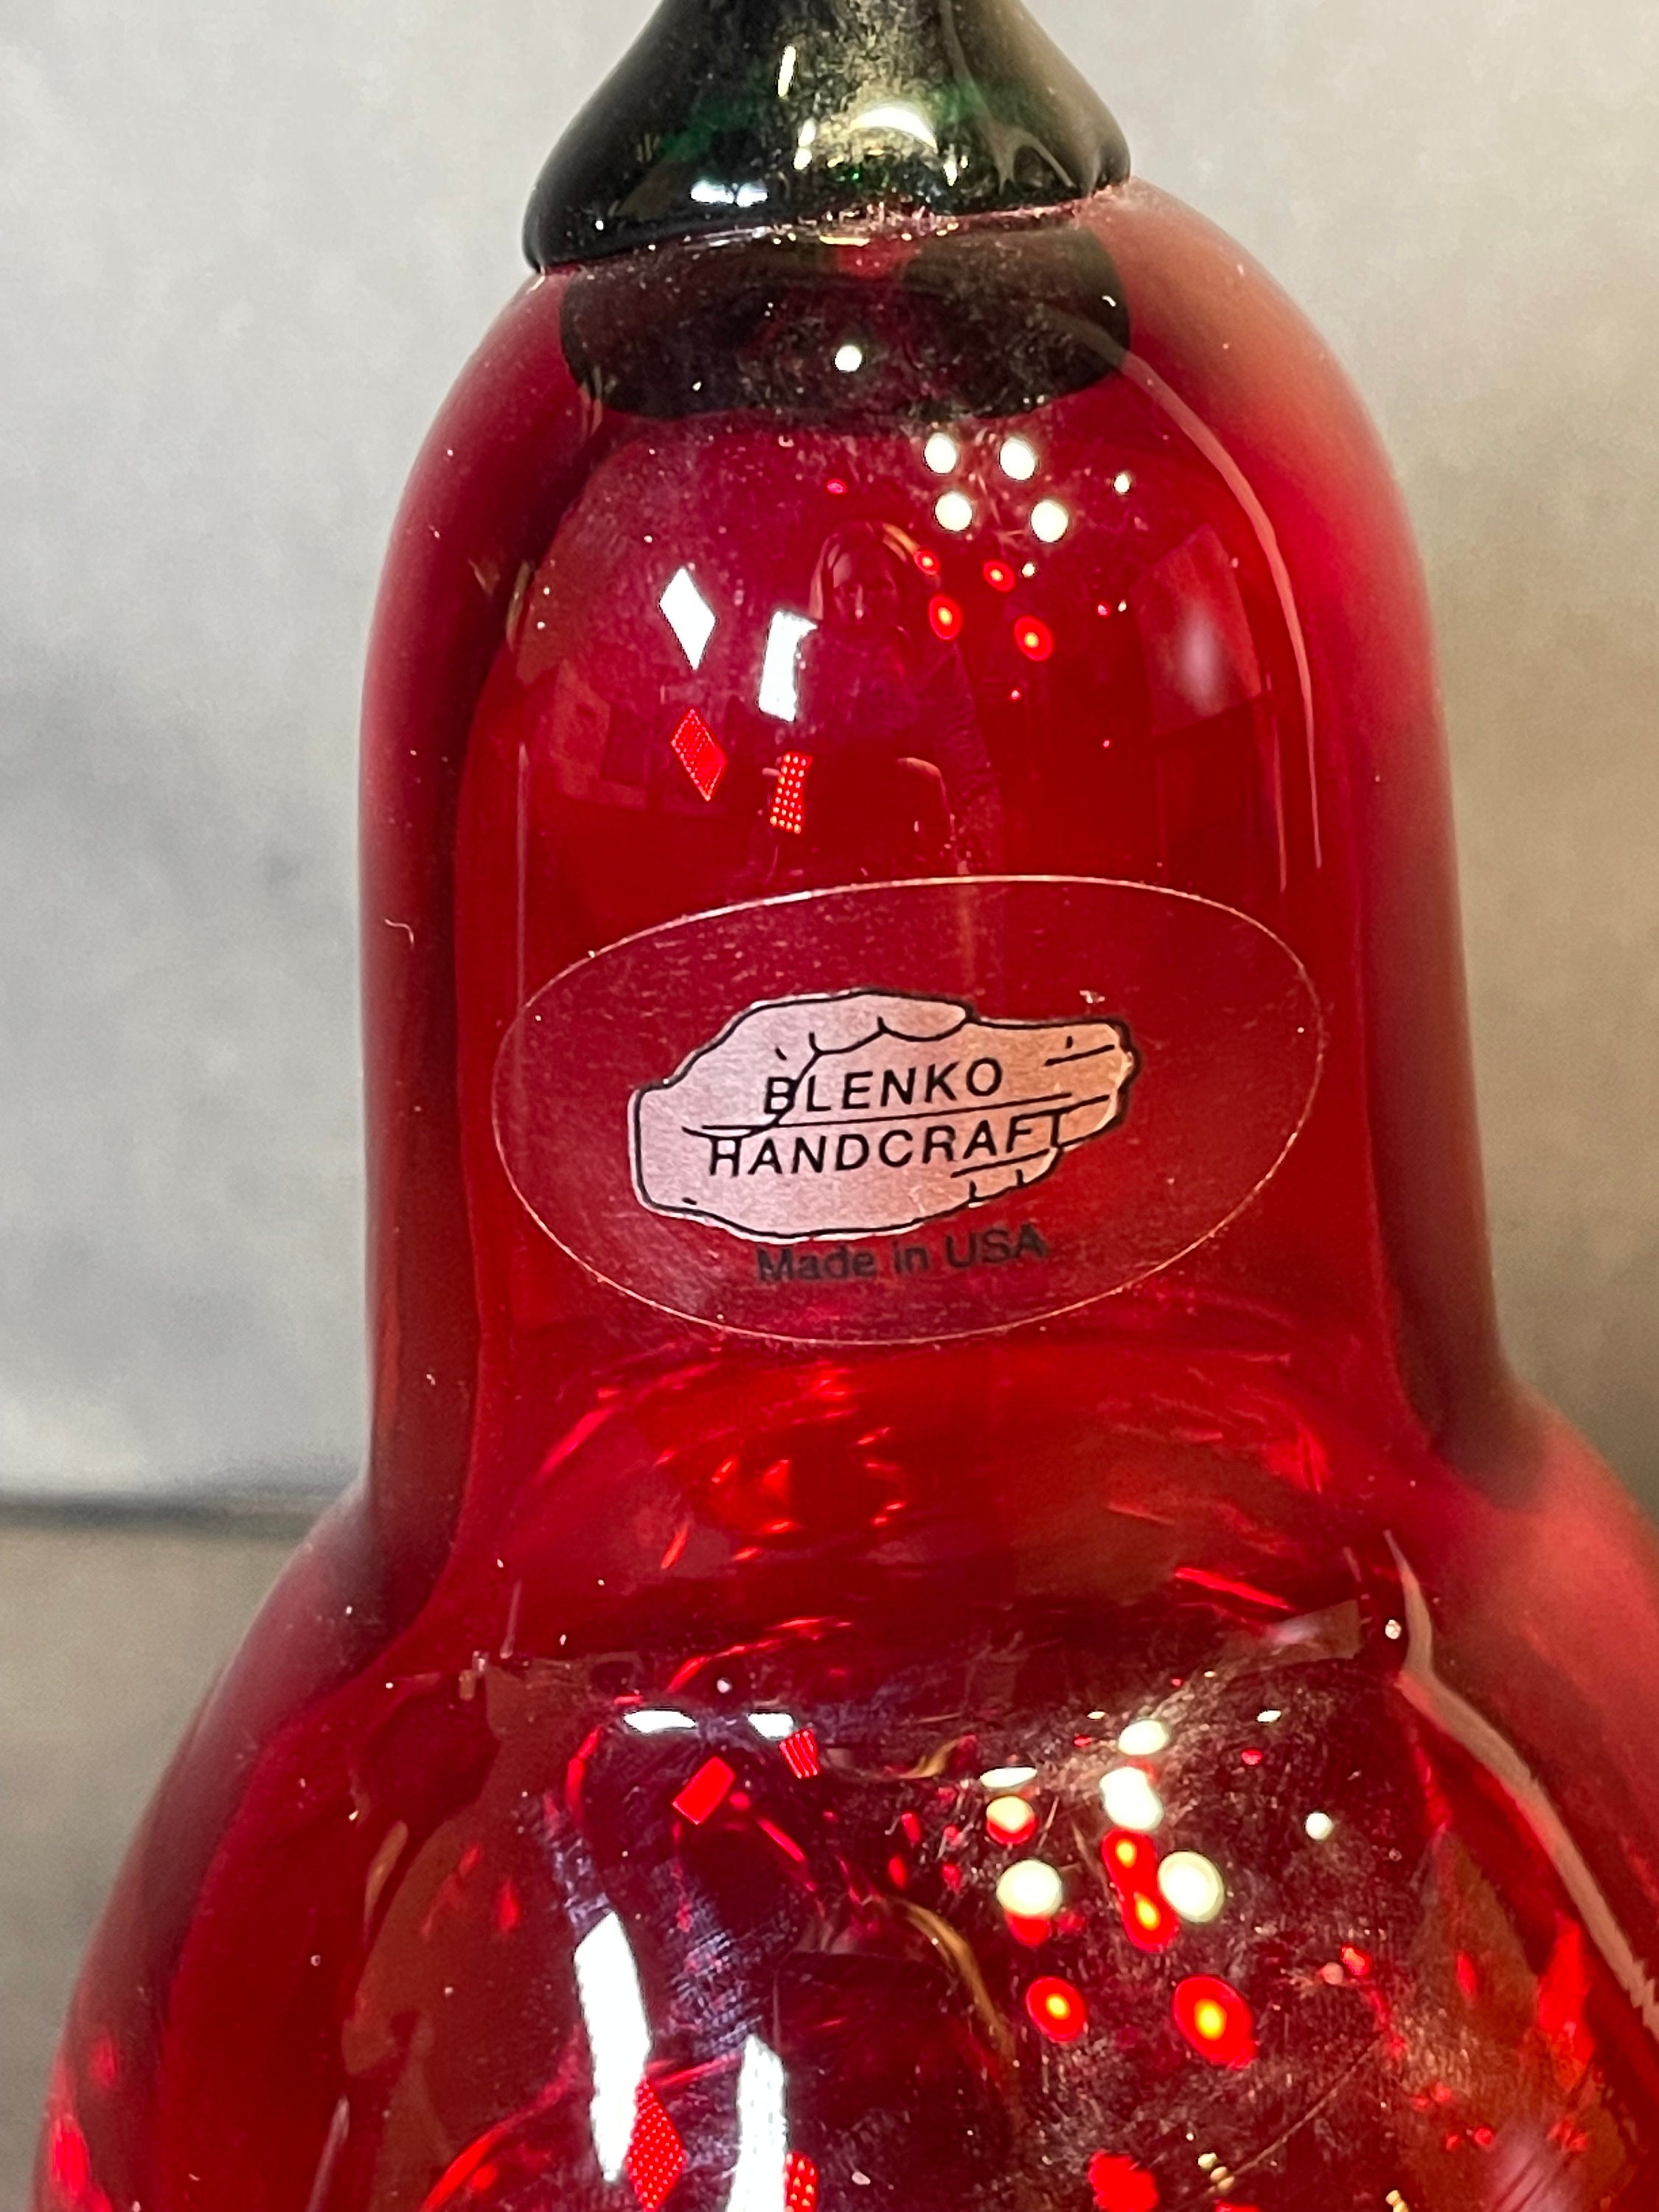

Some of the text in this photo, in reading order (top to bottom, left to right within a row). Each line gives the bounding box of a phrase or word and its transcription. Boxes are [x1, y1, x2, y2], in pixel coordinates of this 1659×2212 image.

[764, 1057, 1003, 1115] BLENKO
[709, 1110, 1066, 1178] HANDCRAFT
[755, 1222, 1048, 1284] Made in USA
